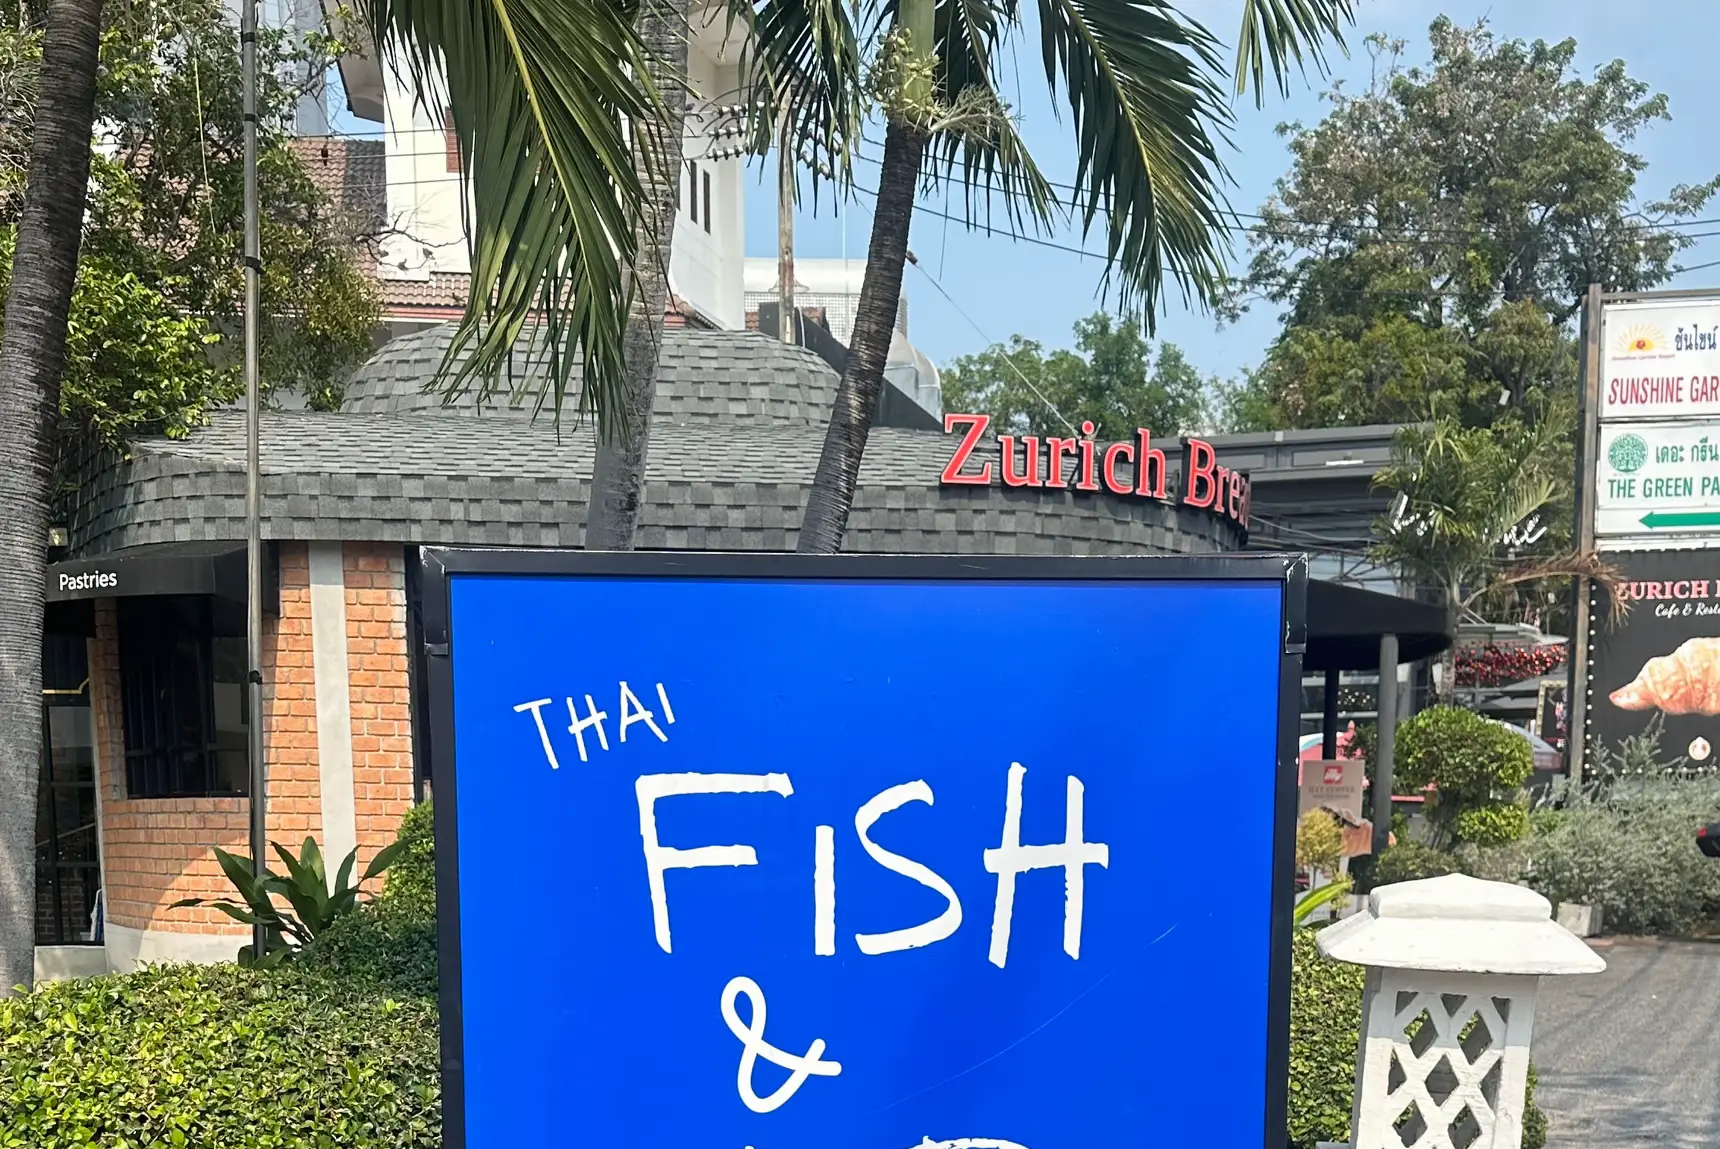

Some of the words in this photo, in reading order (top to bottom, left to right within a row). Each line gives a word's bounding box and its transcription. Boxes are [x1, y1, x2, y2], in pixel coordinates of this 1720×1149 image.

[1608, 377, 1684, 405] SUNSHINE
[1690, 375, 1720, 402] GAR
[941, 413, 1168, 500] Zurich
[1655, 445, 1684, 464] เดอะ
[1607, 478, 1636, 498] THE
[1643, 476, 1693, 498] GREEN
[1701, 476, 1720, 496] PA
[59, 569, 118, 592] Pastries
[1655, 603, 1680, 619] Cafe
[1682, 602, 1693, 616] &
[514, 681, 676, 769] THAI
[635, 761, 1109, 969] FISH
[720, 976, 842, 1113] &
